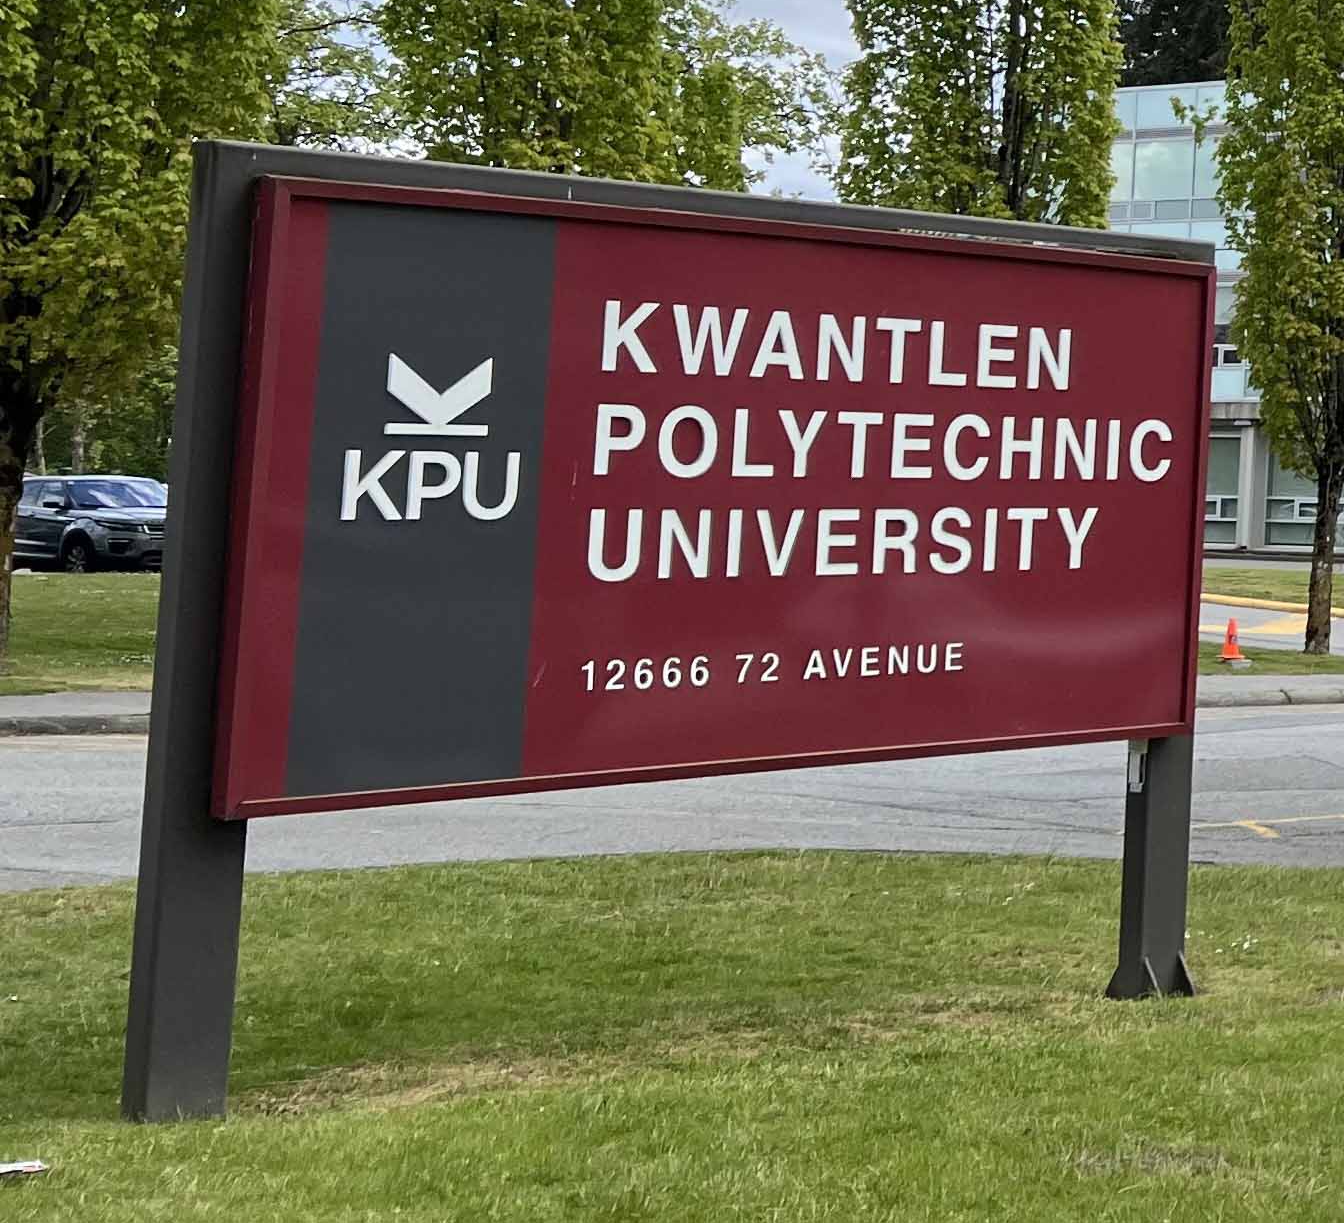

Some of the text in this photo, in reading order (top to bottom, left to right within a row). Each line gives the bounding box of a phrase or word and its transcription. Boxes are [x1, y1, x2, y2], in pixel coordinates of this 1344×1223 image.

[600, 299, 1073, 392] KWANTLEN
[592, 402, 1174, 483] POLYTECHNIC
[339, 448, 522, 522] KPU
[586, 505, 1100, 583] UNIVERSITY
[580, 641, 965, 692] 12666 72 AVENUE
